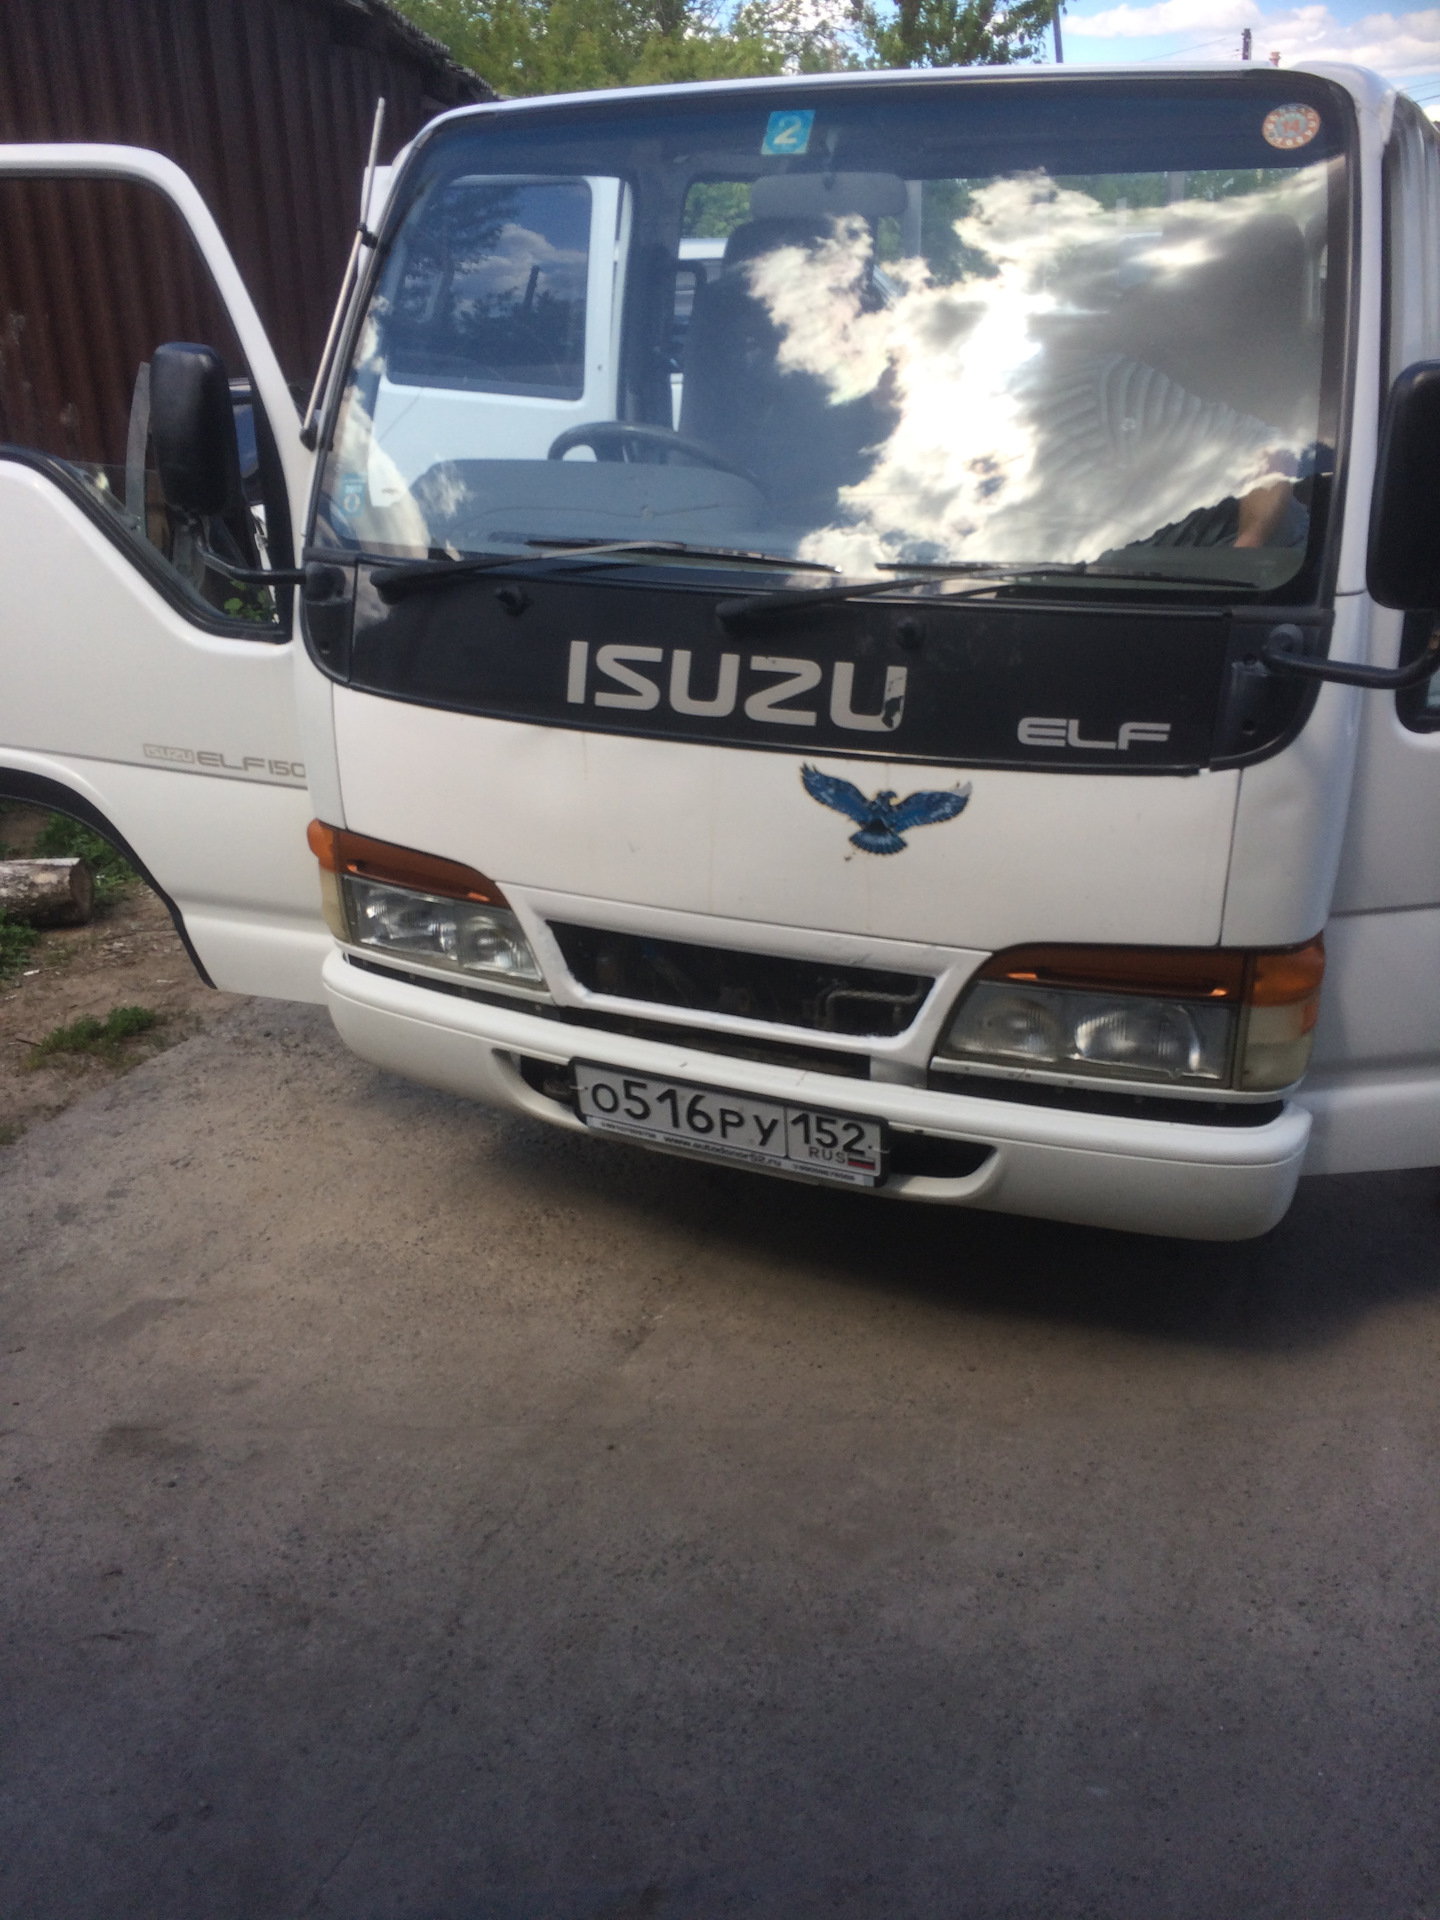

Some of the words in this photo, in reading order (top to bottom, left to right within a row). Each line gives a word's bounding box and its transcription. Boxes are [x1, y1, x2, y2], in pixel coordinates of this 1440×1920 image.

[773, 115, 802, 145] 2
[567, 640, 908, 733] ISUZU
[1017, 717, 1172, 751] ELF
[790, 1112, 867, 1157] 152
[808, 1146, 846, 1164] RUS
